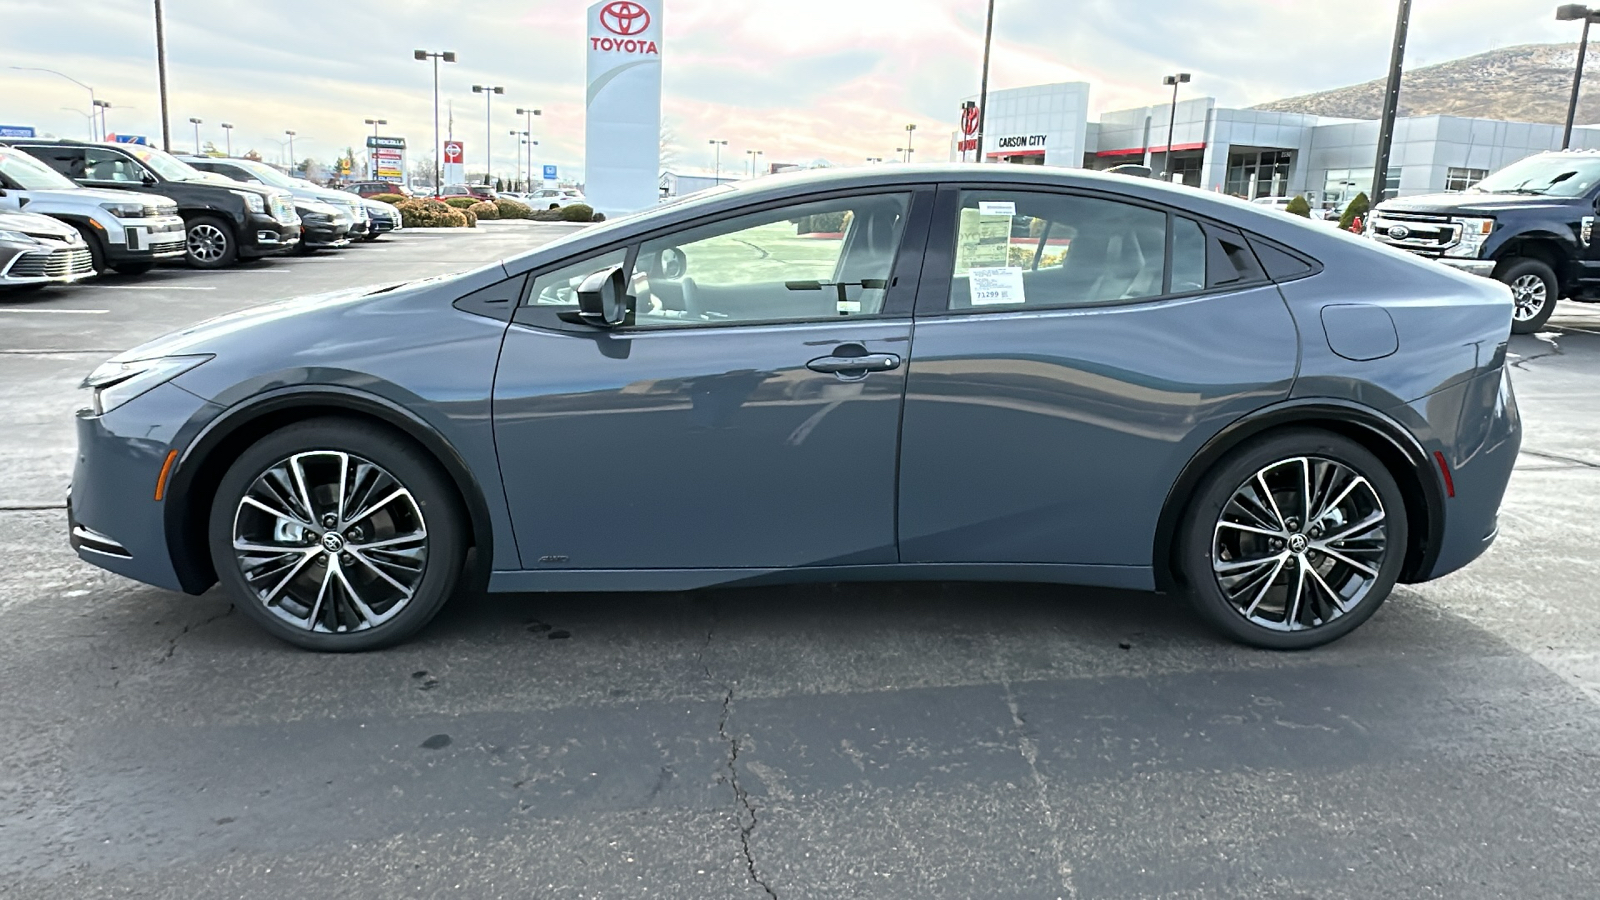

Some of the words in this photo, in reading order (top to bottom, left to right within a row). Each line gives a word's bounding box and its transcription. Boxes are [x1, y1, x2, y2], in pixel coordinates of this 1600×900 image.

[590, 37, 658, 54] TOYOTA
[999, 136, 1027, 148] CARSON
[1029, 134, 1047, 146] CITY
[977, 291, 999, 299] 71299
